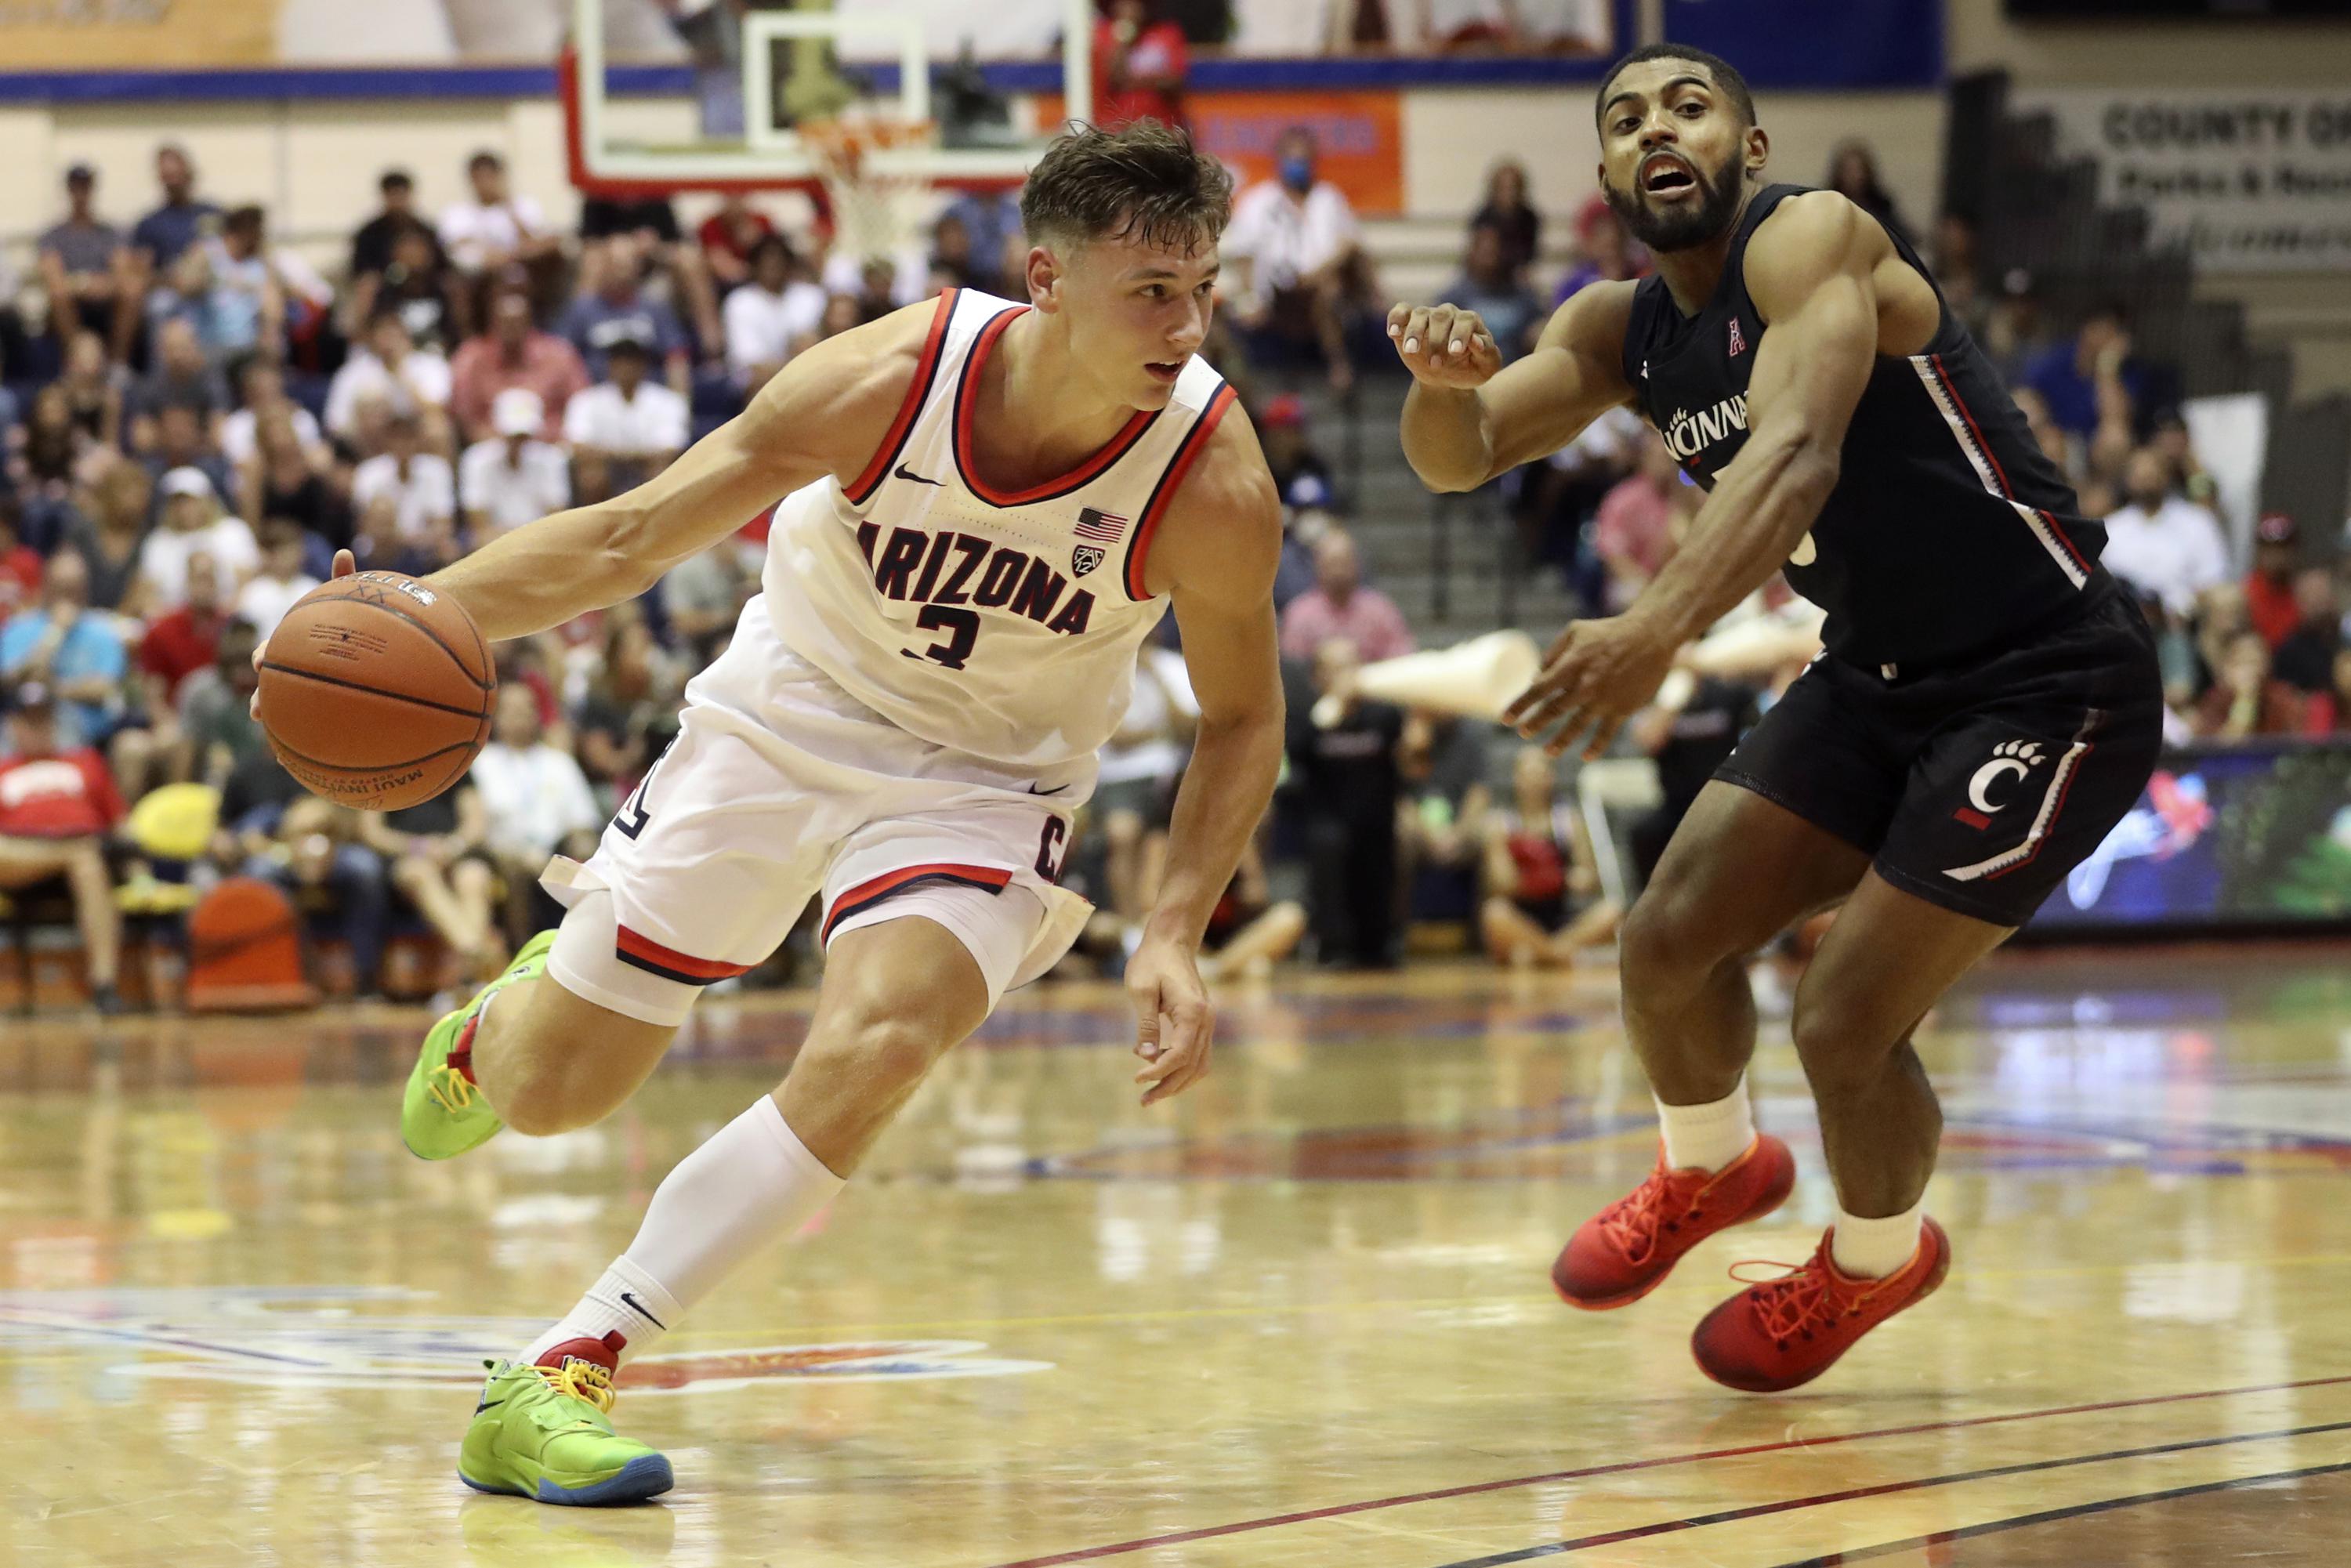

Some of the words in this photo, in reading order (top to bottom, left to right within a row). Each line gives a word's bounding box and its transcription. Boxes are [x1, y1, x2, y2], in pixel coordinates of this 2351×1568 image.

[2103, 105, 2294, 147] COUNTY
[1662, 390, 1748, 461] NCINNA
[1074, 561, 1094, 574] 12
[375, 769, 423, 791] MAUI
